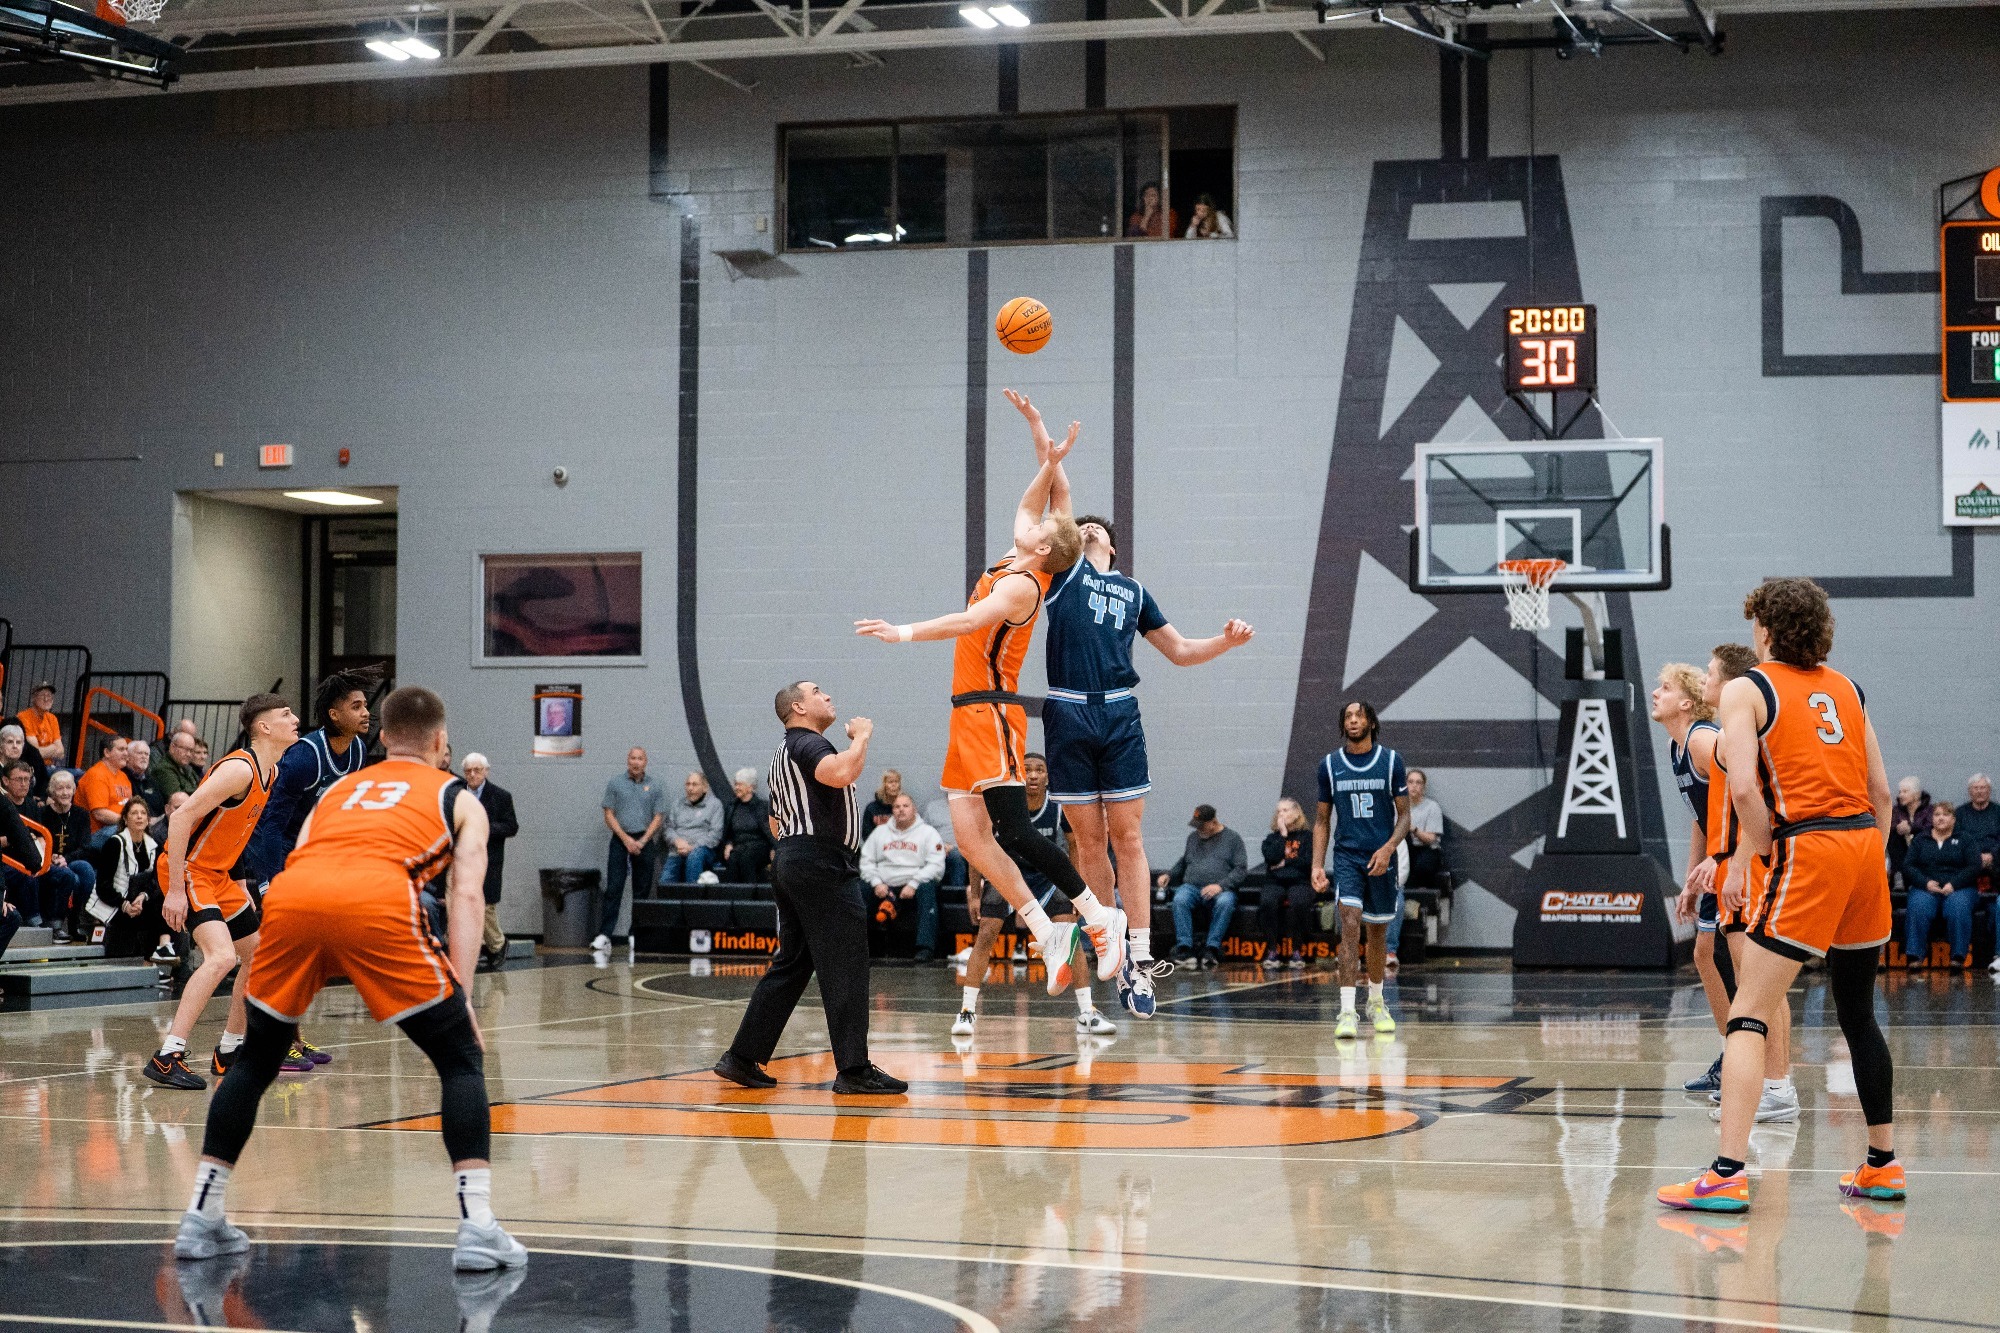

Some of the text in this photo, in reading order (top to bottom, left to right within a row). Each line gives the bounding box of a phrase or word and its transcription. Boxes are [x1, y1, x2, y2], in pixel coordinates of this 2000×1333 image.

[1509, 308, 1585, 334] 20:00
[1520, 339, 1576, 386] 30
[264, 445, 286, 465] EXIT
[1088, 591, 1126, 631] 44
[1808, 692, 1845, 745] 3
[341, 780, 411, 811] 13
[1350, 793, 1374, 818] 12
[1542, 892, 1641, 911] CHATELAIN
[713, 931, 780, 953] findlay
